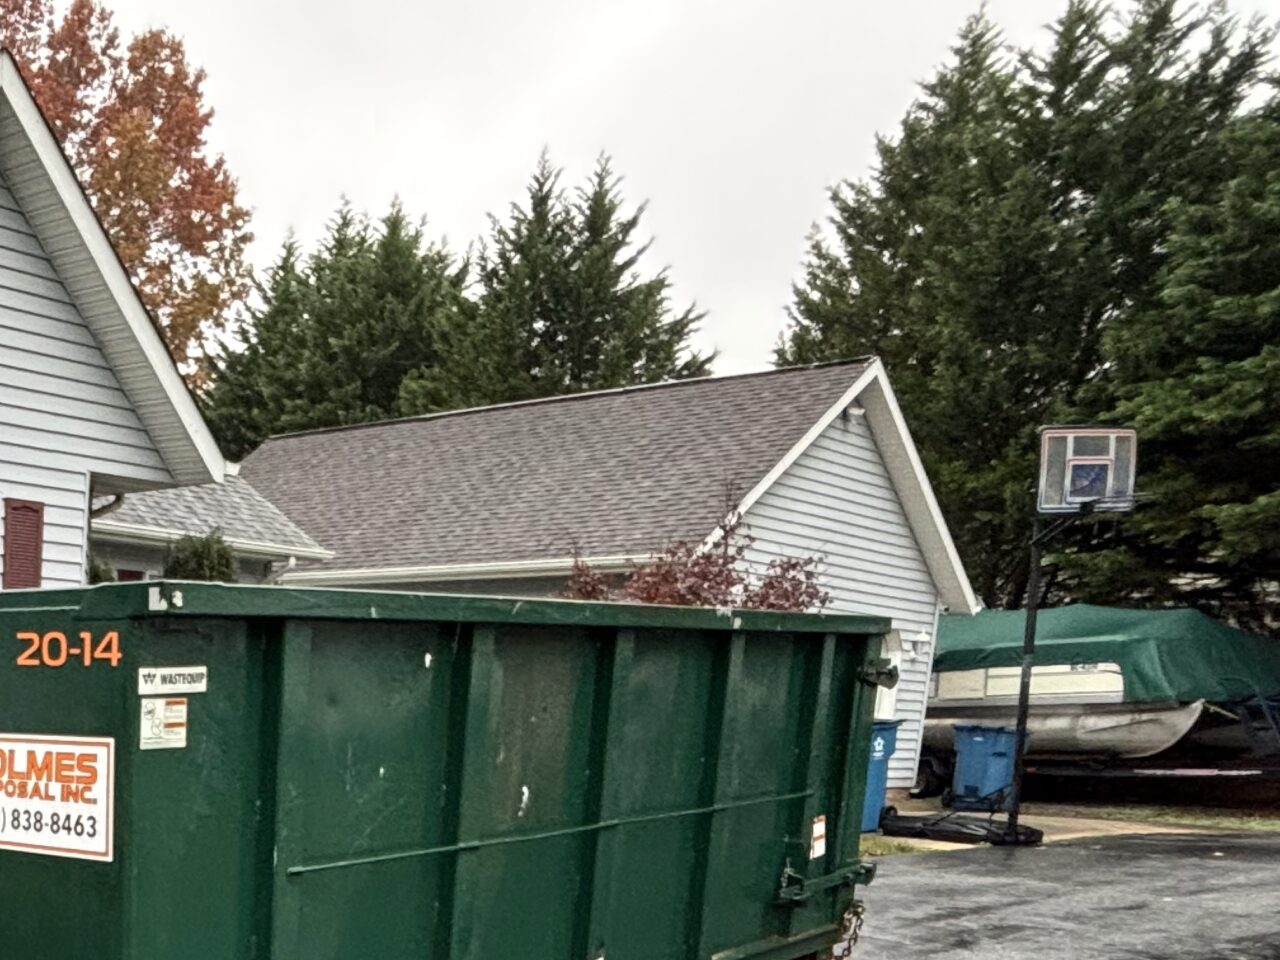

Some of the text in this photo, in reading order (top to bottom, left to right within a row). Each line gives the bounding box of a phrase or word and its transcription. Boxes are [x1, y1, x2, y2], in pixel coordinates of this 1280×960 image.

[16, 631, 123, 667] 20-14
[160, 672, 206, 685] WASTEQUIP
[60, 783, 98, 805] INC.
[11, 808, 97, 838] 838-8463
